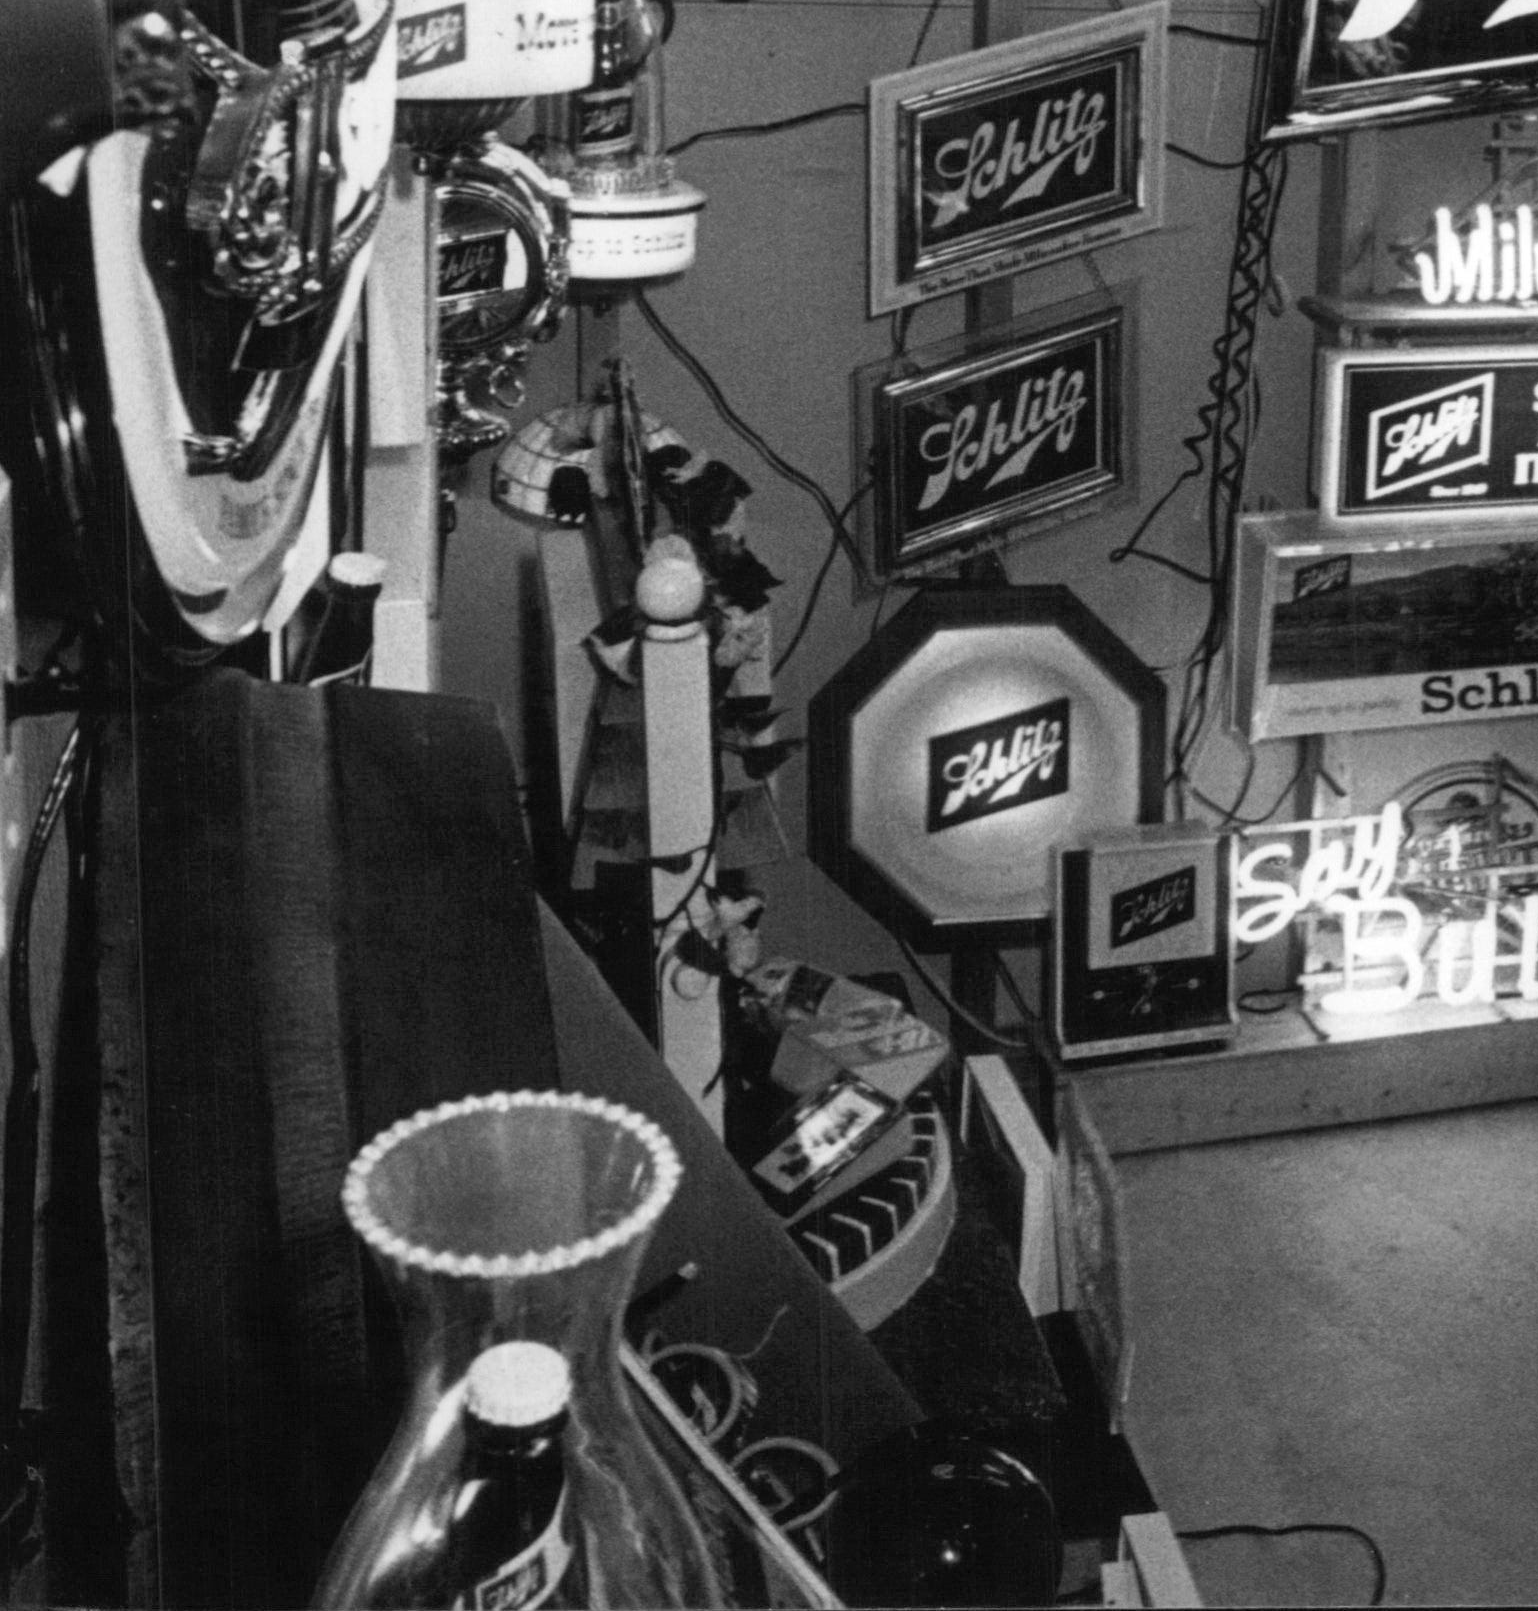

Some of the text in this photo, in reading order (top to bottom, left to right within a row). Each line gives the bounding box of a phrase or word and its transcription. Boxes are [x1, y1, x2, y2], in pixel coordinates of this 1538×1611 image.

[931, 87, 1108, 229] Schlitz
[918, 365, 1087, 510] Schlitz
[941, 718, 1063, 817] Schlitz
[1236, 800, 1403, 945] Say
